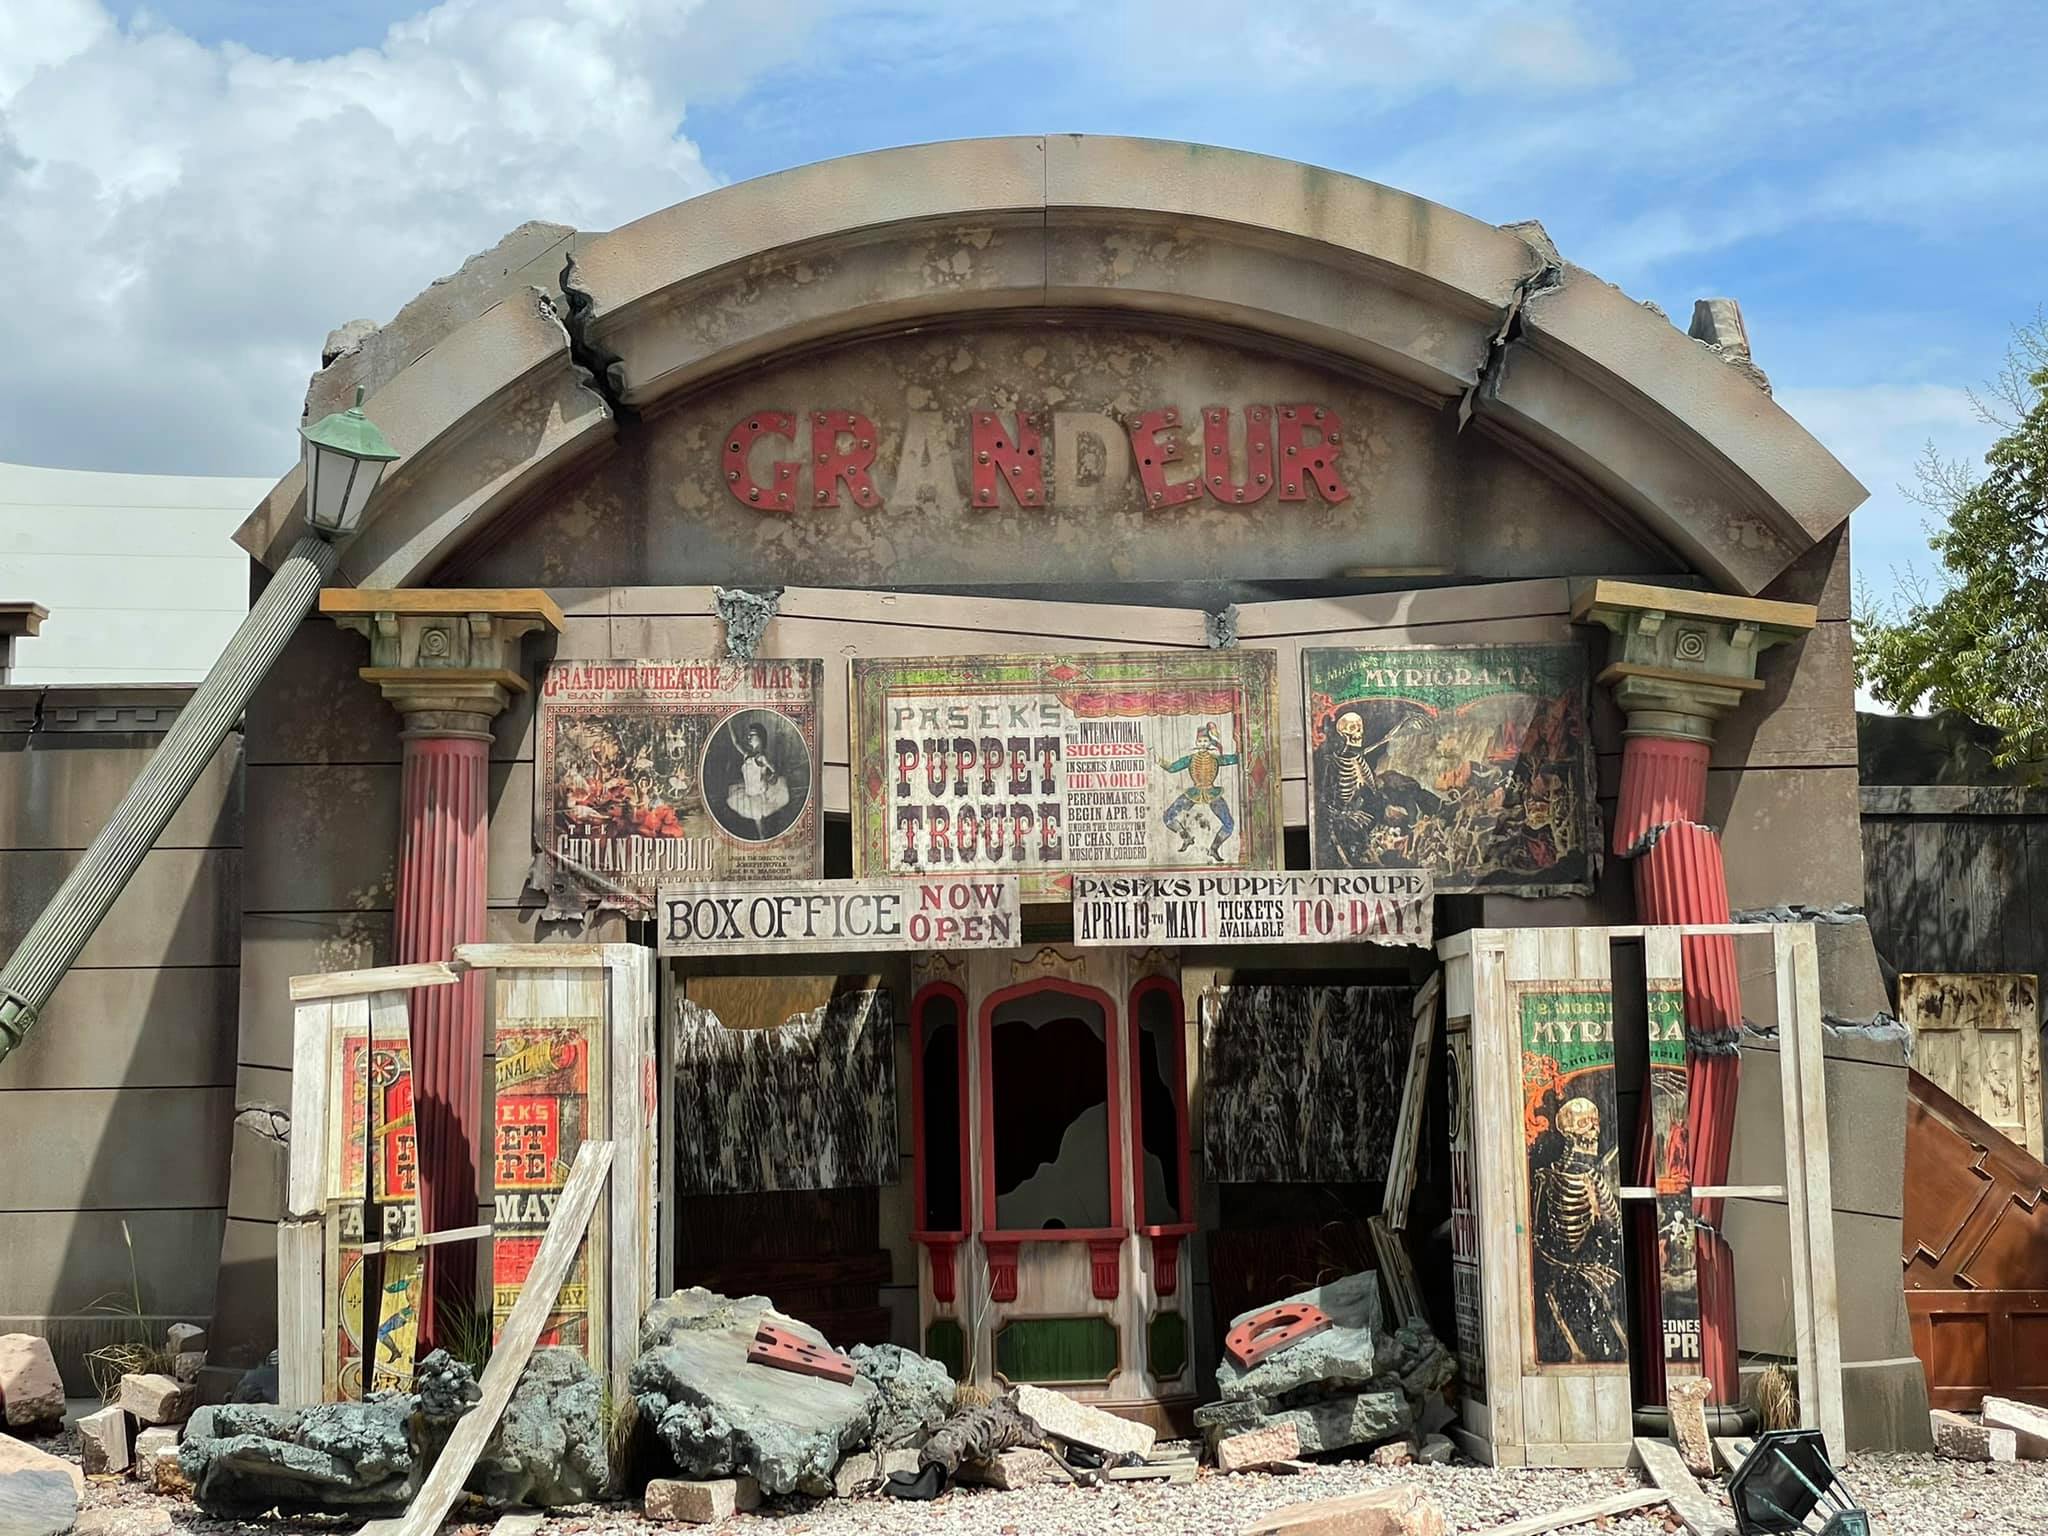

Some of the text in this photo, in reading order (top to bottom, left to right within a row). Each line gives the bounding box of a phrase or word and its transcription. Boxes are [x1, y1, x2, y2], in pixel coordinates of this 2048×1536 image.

[722, 404, 1351, 513] GRANDEUR
[544, 667, 639, 696] GRANDEUR
[641, 667, 720, 690] THEATRE
[568, 690, 712, 699] SAN FRANCISCO
[894, 701, 1061, 730] PASEK'S
[1079, 721, 1144, 744] INTERNATIONAL
[1066, 744, 1145, 756] SUCCESS
[896, 735, 1061, 797] PUPPET
[1066, 760, 1145, 773] IN SCENES AROUND
[1067, 773, 1145, 788] THE WORLD
[1068, 791, 1146, 806] PERFORMANCES
[1068, 807, 1102, 821] BEGIN
[1106, 807, 1131, 820] APR.
[568, 824, 607, 835] THE
[896, 803, 1062, 864] TROUPE
[1068, 821, 1146, 832] UNDER THE DIRECTION
[1068, 832, 1146, 846] OF CHAS. GRAY
[630, 834, 713, 874] REPUBLIC
[1069, 847, 1093, 861] MUSIC
[1094, 847, 1104, 860] BY
[1113, 846, 1147, 860] CORDERO
[919, 883, 1005, 911] NOW
[1079, 875, 1424, 898] PASEK'S PUPPET TROUPE
[665, 894, 900, 941] BOX OFFICE
[1081, 901, 1130, 939] APRIL
[1134, 900, 1150, 939] 19
[1152, 913, 1164, 924] TO
[1165, 900, 1199, 939] MAY
[1218, 901, 1284, 920] TICKETS
[909, 912, 1012, 942] OPEN
[1219, 921, 1284, 938] AVAILABLE
[496, 1055, 529, 1083] INAL
[496, 1103, 549, 1121] EK'S
